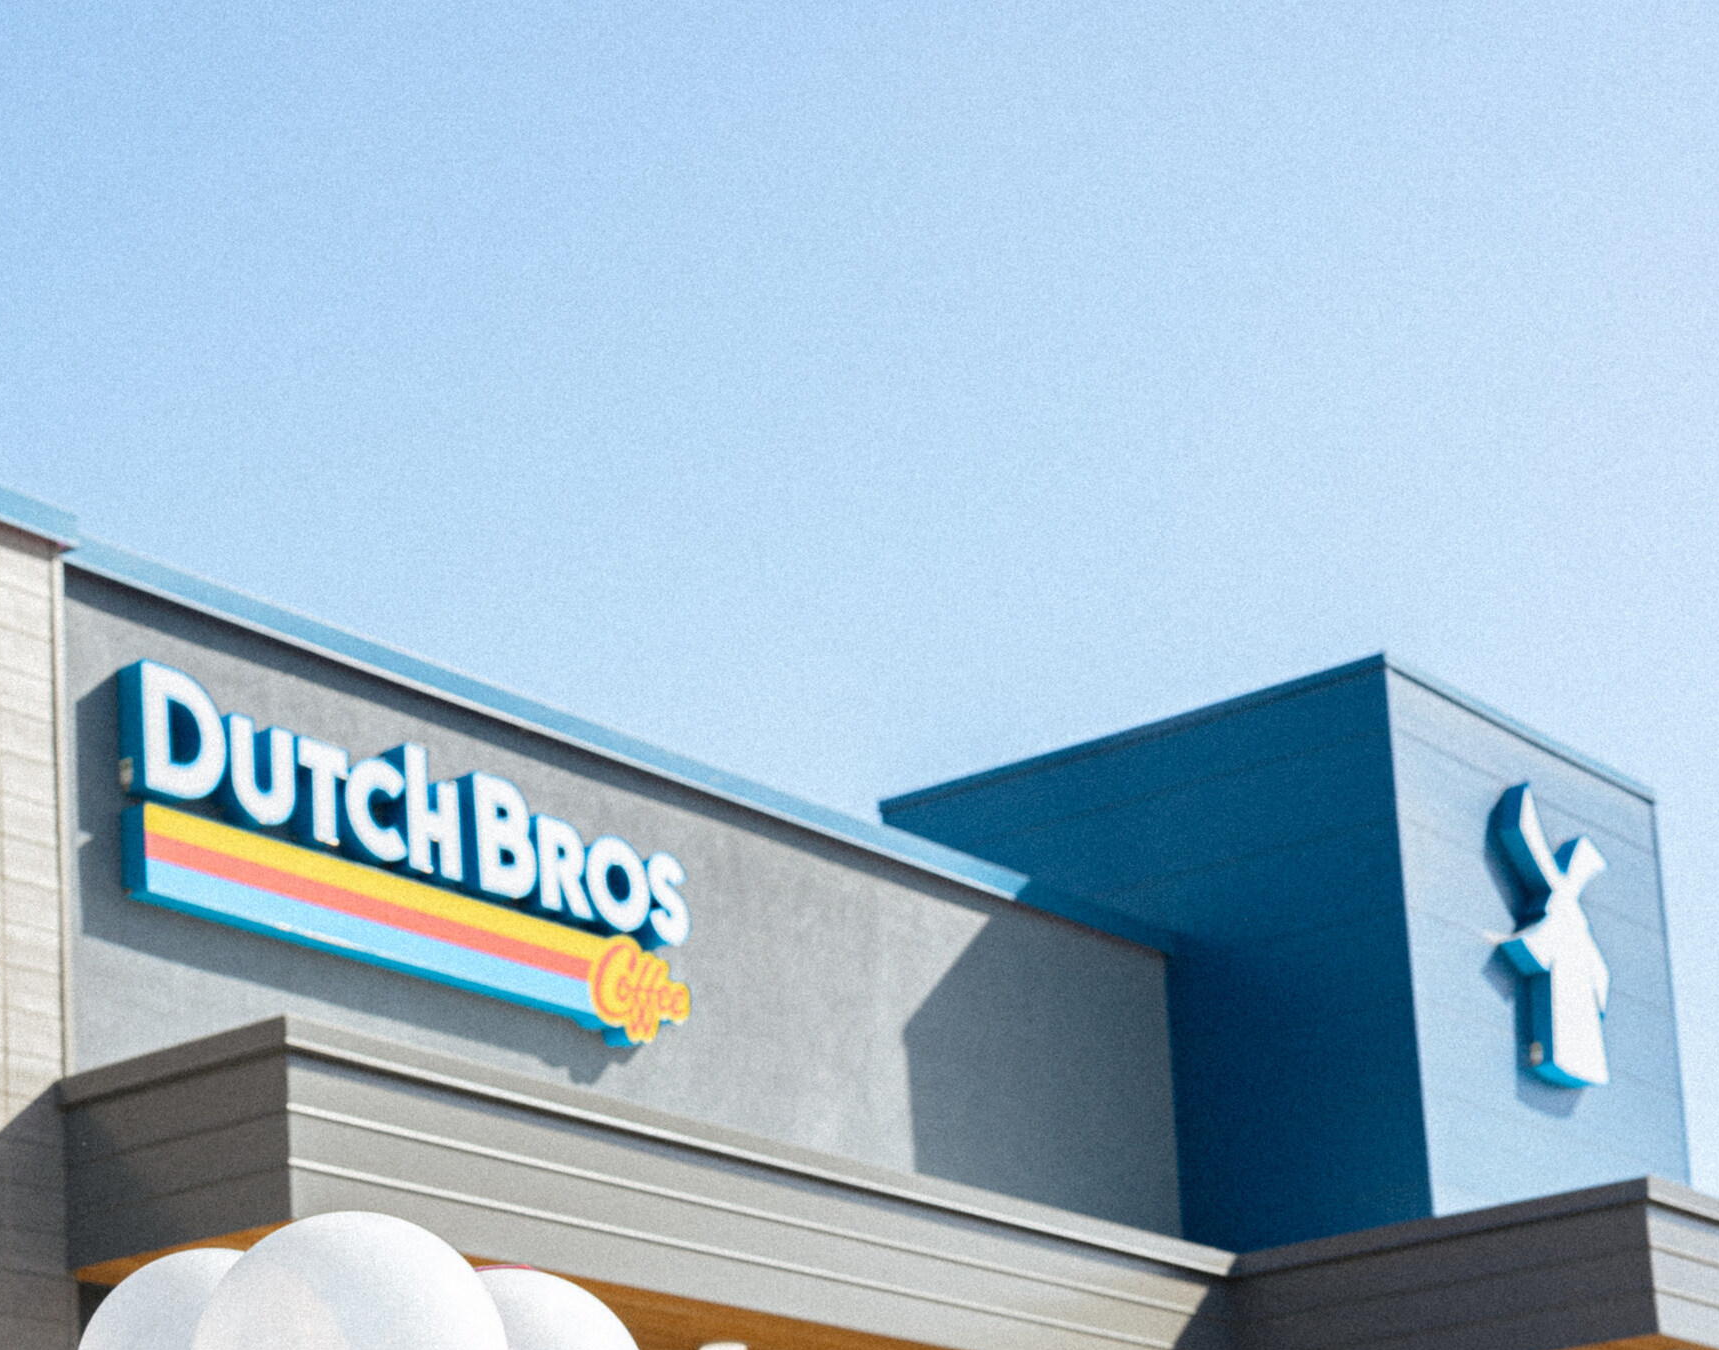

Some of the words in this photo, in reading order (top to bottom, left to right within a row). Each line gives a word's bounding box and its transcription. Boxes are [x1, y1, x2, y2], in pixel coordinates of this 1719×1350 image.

[141, 659, 465, 882] DUTCH
[472, 771, 691, 947] BROS
[593, 941, 687, 1036] Coffee
